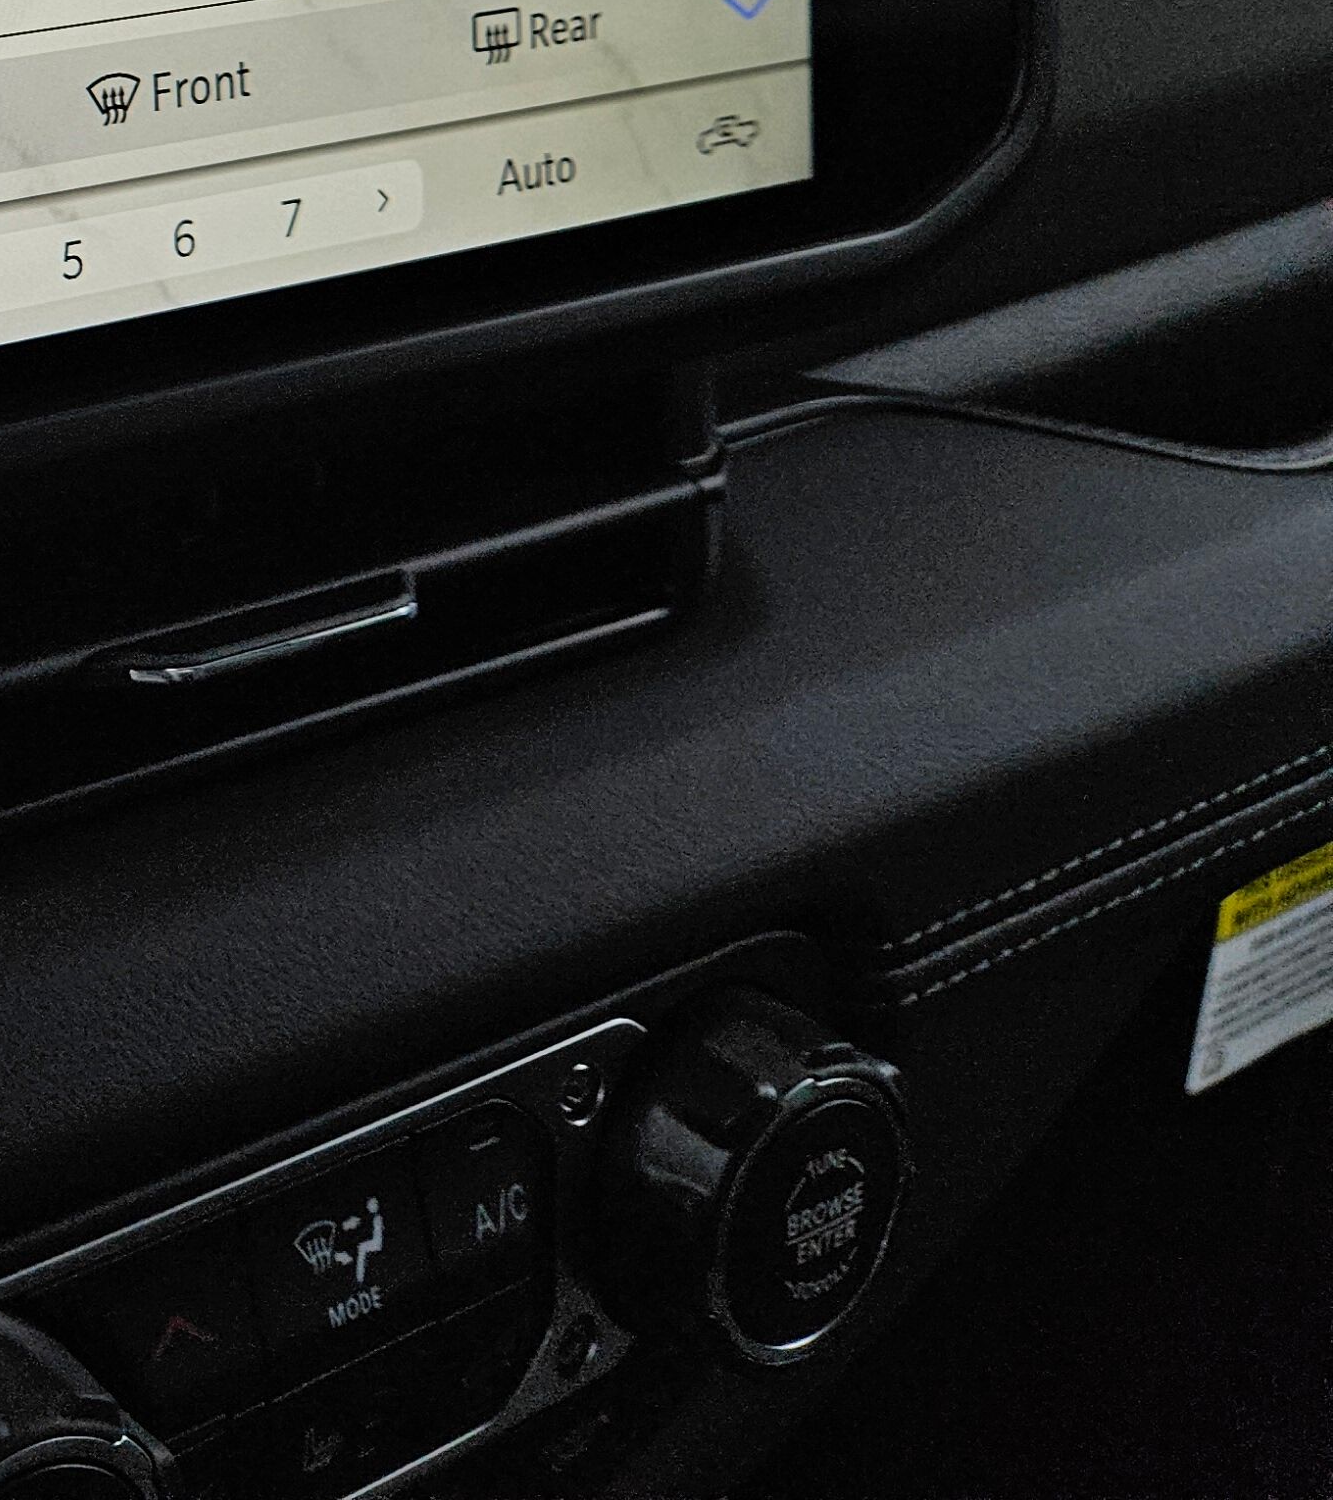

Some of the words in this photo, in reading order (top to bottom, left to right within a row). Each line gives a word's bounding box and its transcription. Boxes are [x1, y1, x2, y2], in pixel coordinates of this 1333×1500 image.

[530, 12, 601, 49] Rear
[153, 61, 251, 112] Front
[498, 156, 574, 195] Auto
[63, 239, 83, 280] 5
[174, 219, 195, 258] 6
[281, 198, 302, 237] 7
[474, 1183, 529, 1243] A/C
[787, 1181, 865, 1238] BROWSE
[796, 1219, 857, 1265] ENTER
[327, 1285, 384, 1329] MODE
